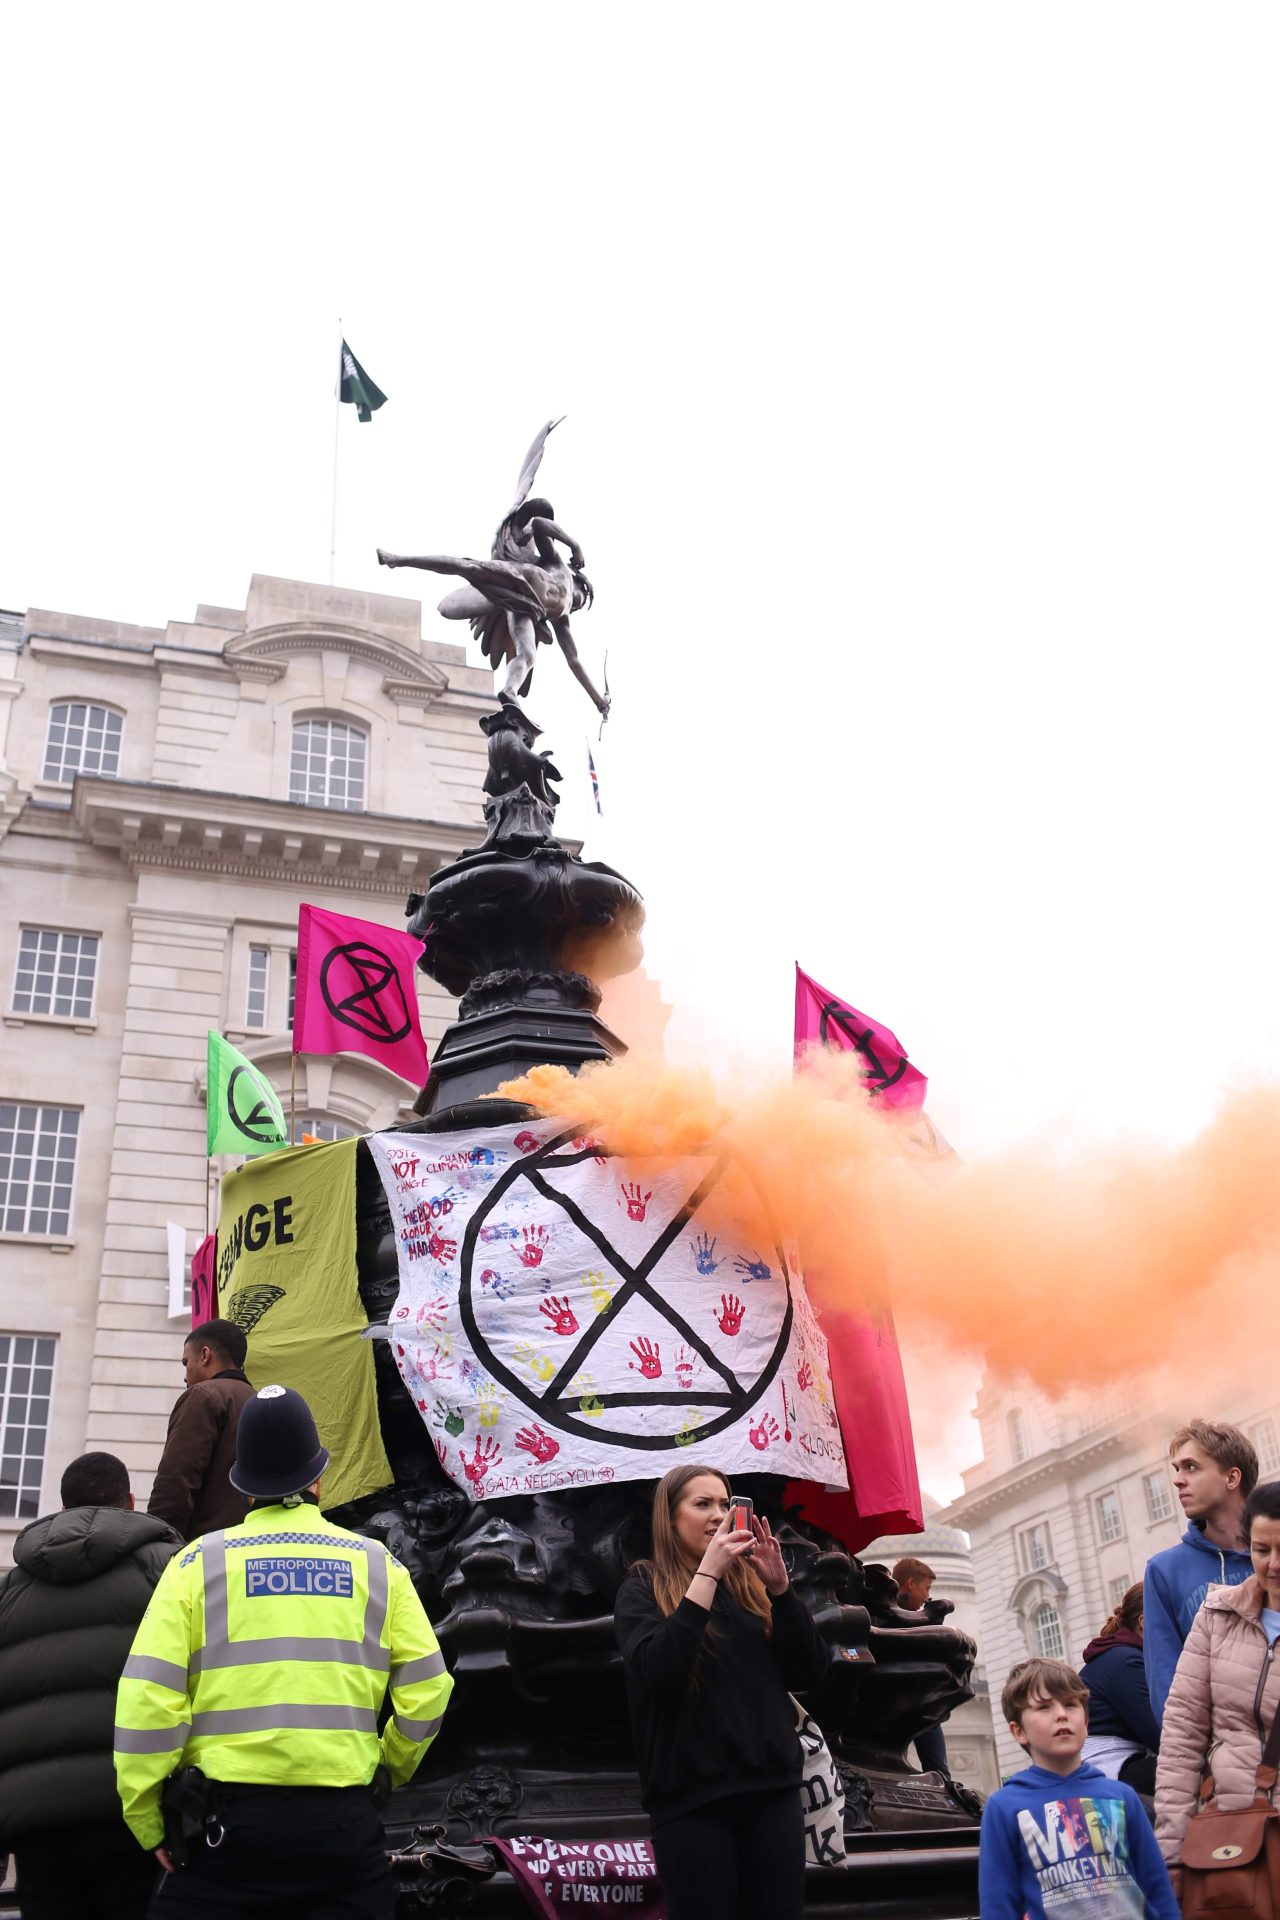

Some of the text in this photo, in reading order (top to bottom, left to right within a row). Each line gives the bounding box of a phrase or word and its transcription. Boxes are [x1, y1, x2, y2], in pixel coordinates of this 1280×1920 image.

[486, 1468, 595, 1493] GAIA NEEDS YOU
[247, 1559, 351, 1573] METROPOLITAN
[248, 1571, 351, 1595] POLICE
[527, 1859, 657, 1877] ND EVERY PART
[1036, 1856, 1103, 1893] MONKEY
[561, 1883, 644, 1903] EVERYONE
